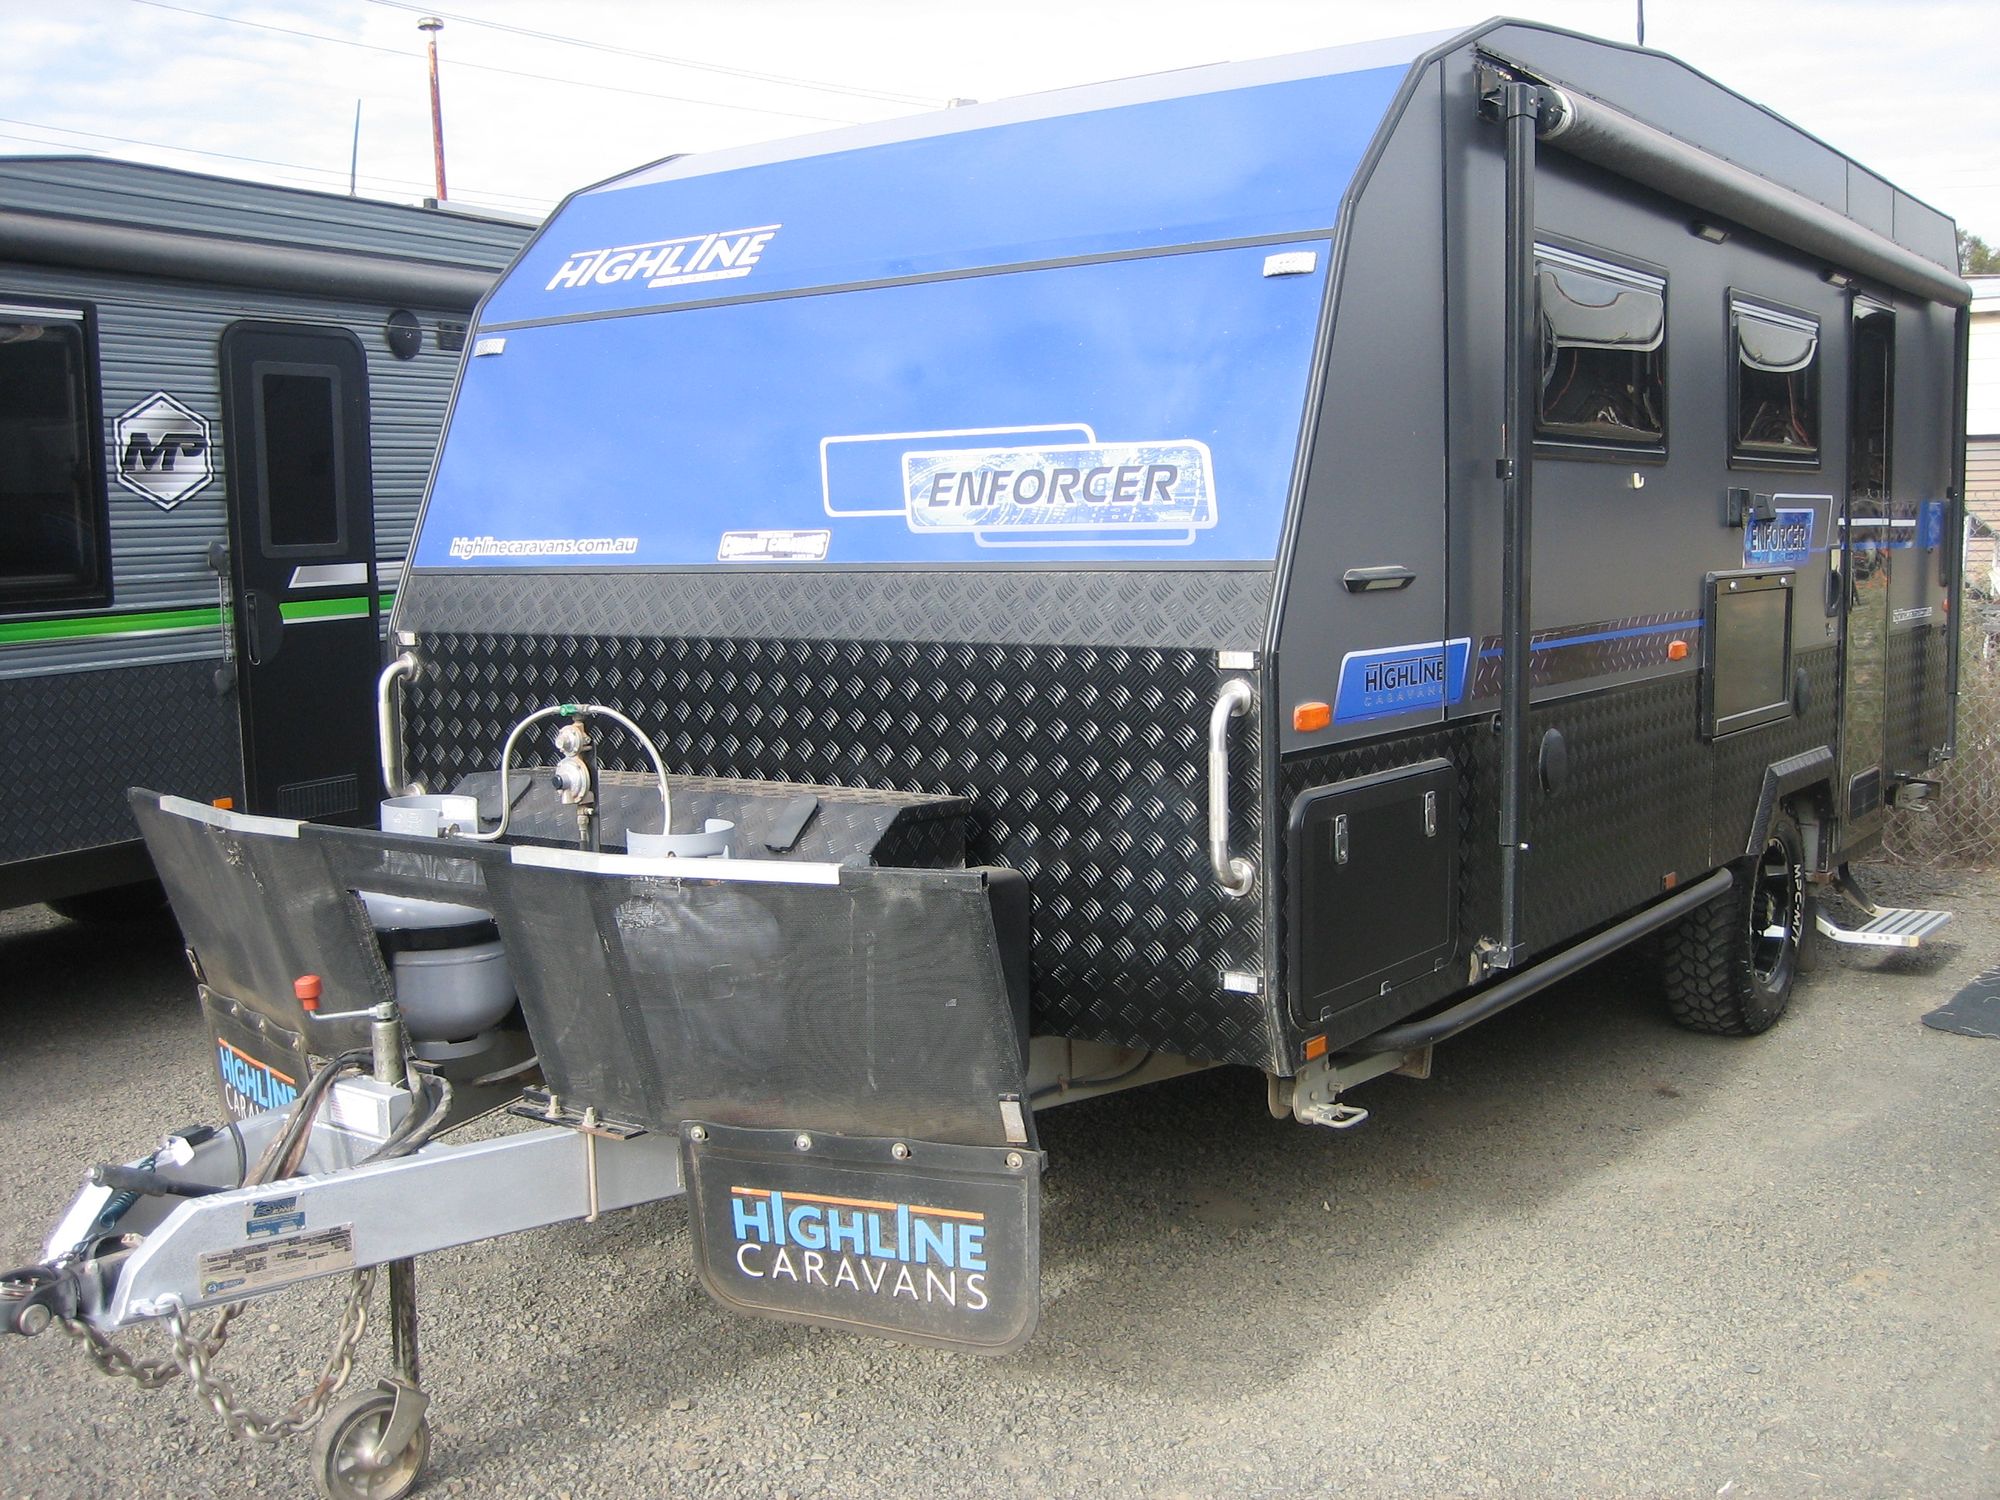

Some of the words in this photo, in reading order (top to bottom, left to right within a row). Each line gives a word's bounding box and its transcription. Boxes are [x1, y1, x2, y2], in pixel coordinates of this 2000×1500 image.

[545, 232, 777, 291] HIGHLINE
[927, 464, 1178, 508] ENFORCER
[451, 538, 637, 559] highlinecaravans.com.au
[1751, 525, 1806, 553] ENFORCER
[1365, 657, 1443, 692] HIGHLINE
[731, 1191, 988, 1272] HIGHLINE
[736, 1243, 988, 1310] CARAVANS
